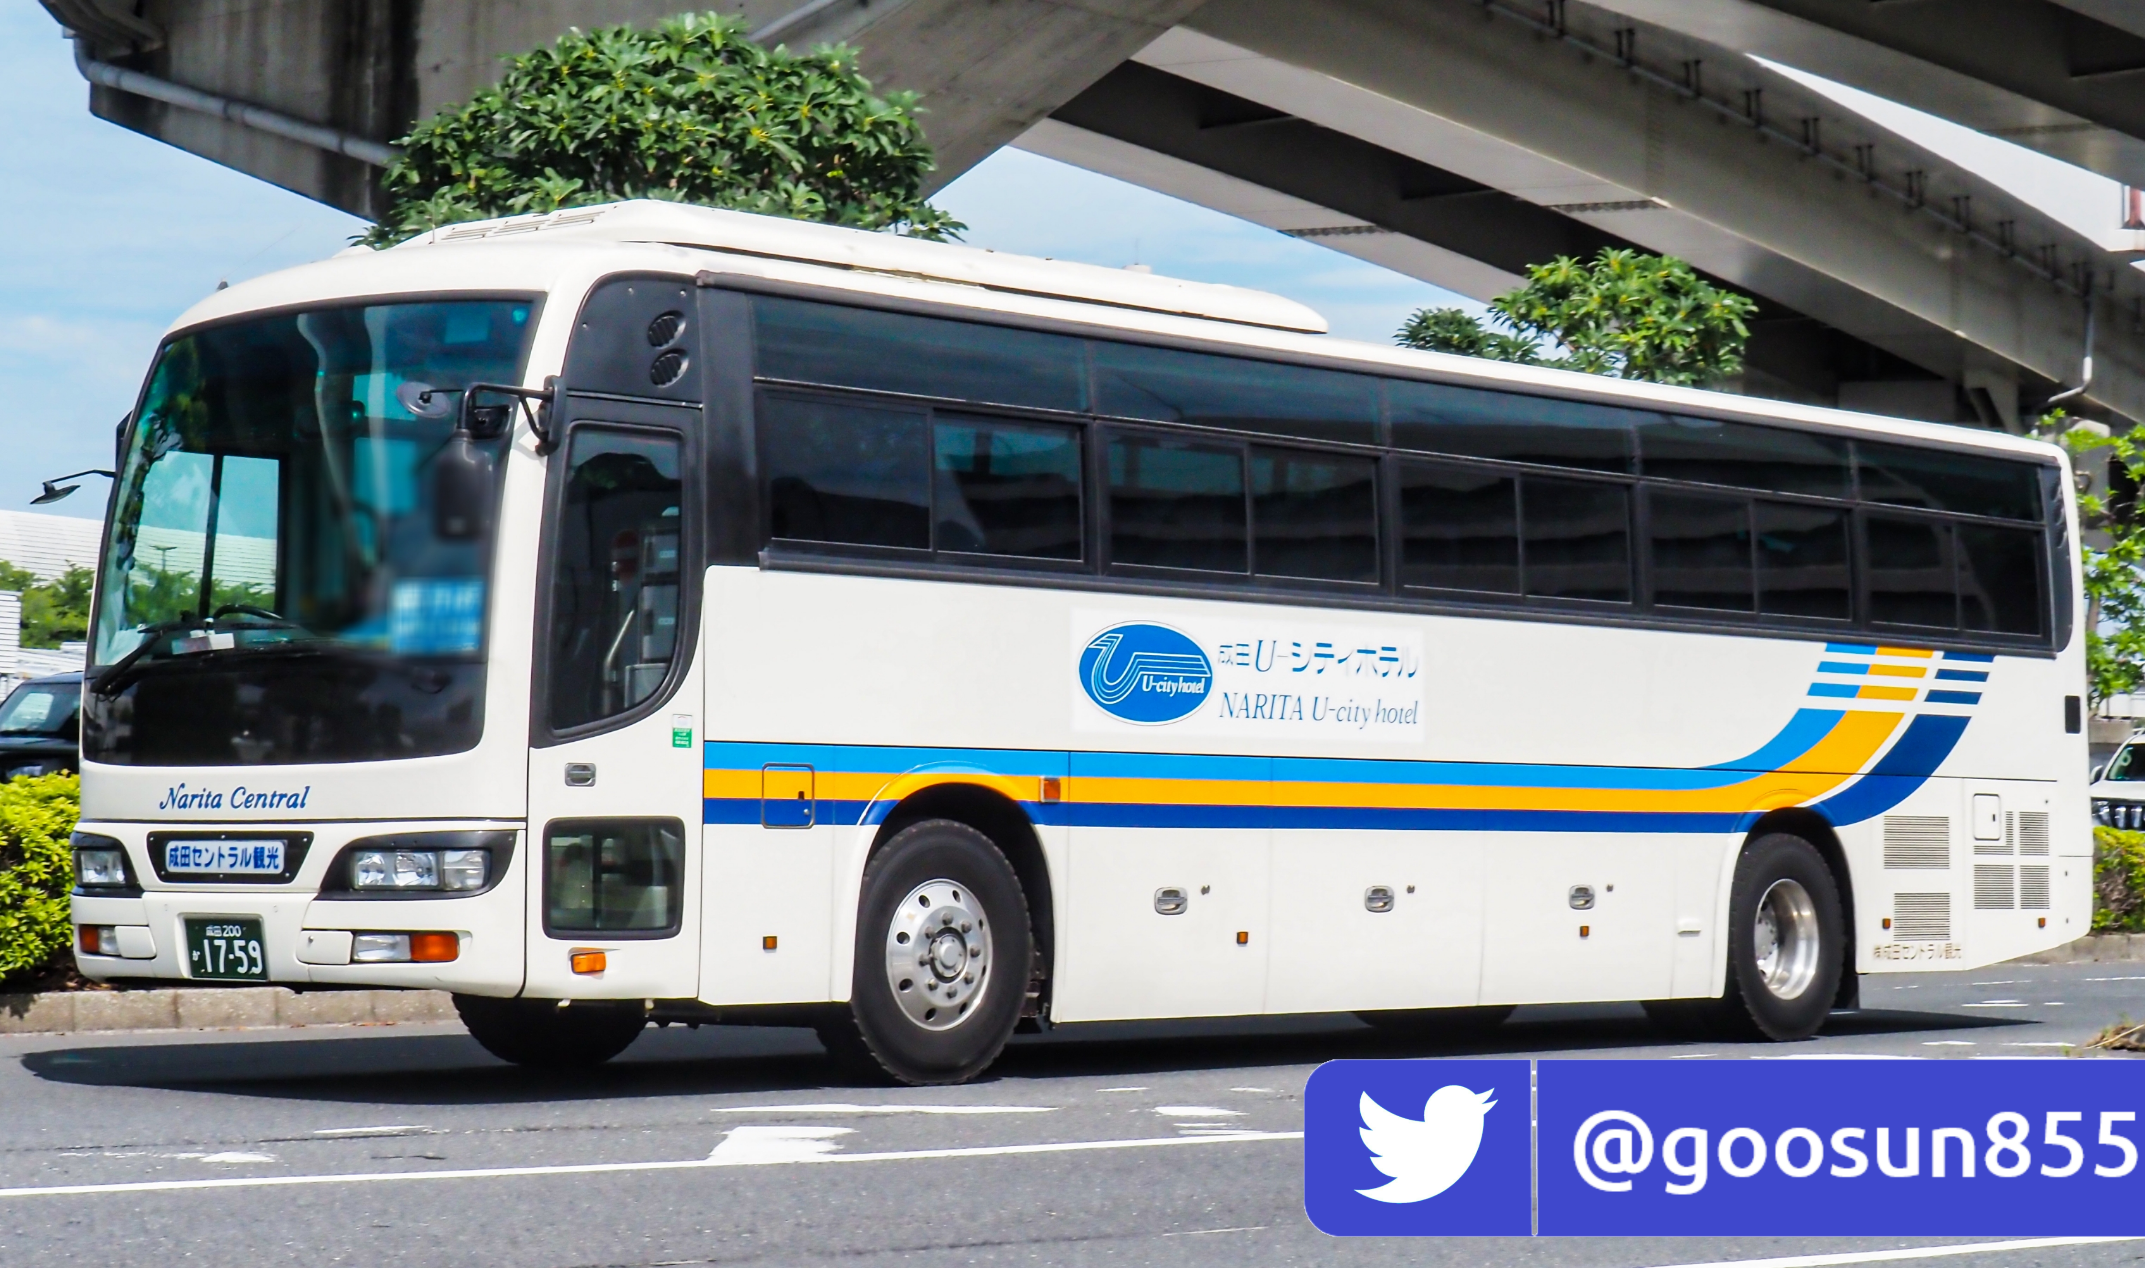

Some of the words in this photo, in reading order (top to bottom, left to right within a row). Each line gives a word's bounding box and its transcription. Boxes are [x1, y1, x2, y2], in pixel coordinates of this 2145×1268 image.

[1219, 692, 1304, 721] NARITA
[1312, 697, 1371, 730] U-city
[1374, 700, 1418, 725] hotel
[159, 782, 224, 810] Narita
[230, 785, 311, 809] Central
[168, 845, 279, 869] 成田セントラル観光
[222, 925, 242, 938] 200
[203, 939, 263, 974] 17-59
